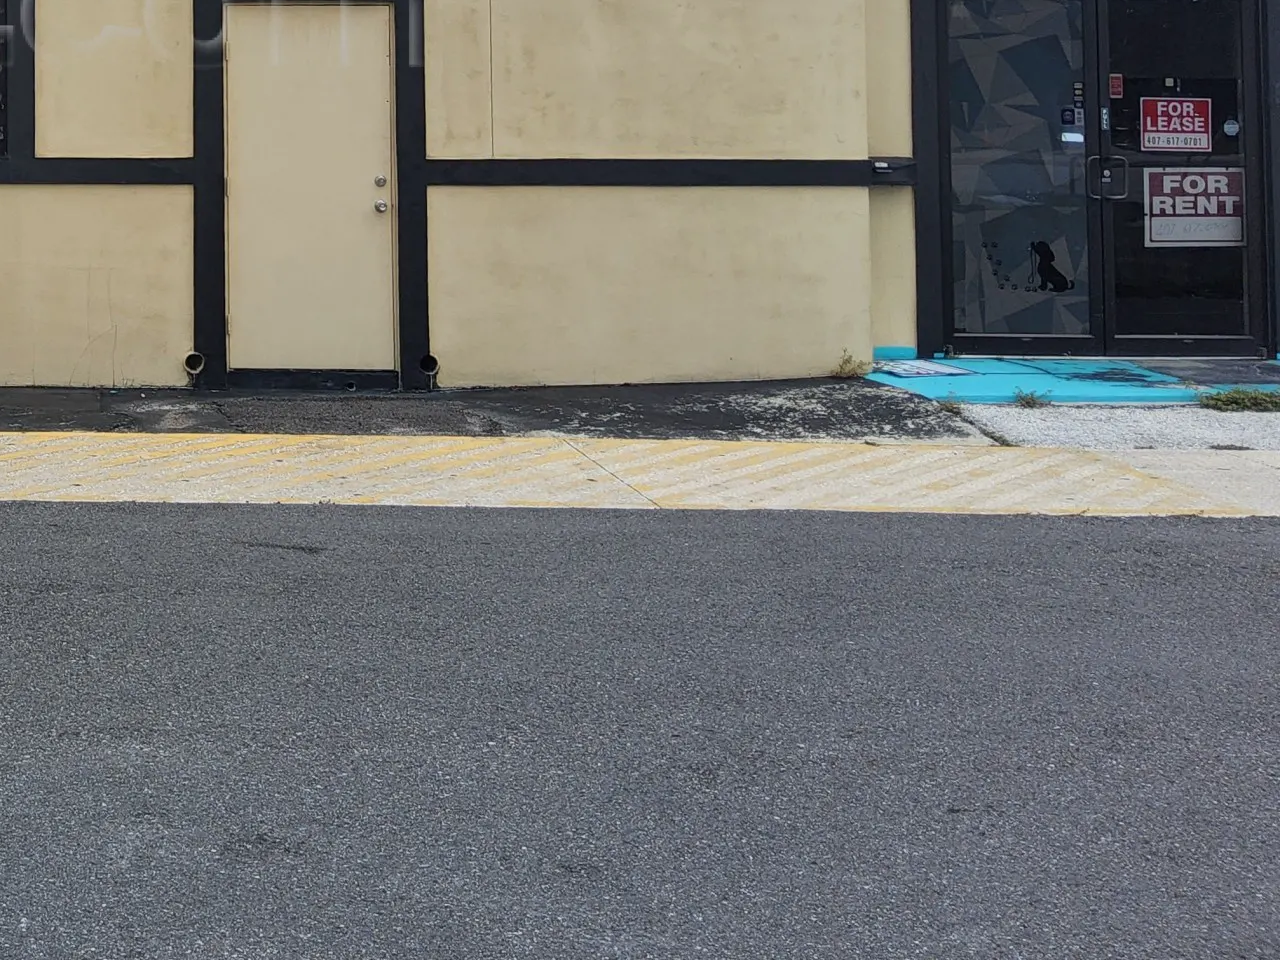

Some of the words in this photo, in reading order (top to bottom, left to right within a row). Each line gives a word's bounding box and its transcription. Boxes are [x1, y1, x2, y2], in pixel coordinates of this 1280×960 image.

[1157, 102, 1194, 116] FOR
[1146, 117, 1205, 132] LEASE
[1163, 175, 1228, 194] FOR
[1152, 196, 1240, 215] RENT
